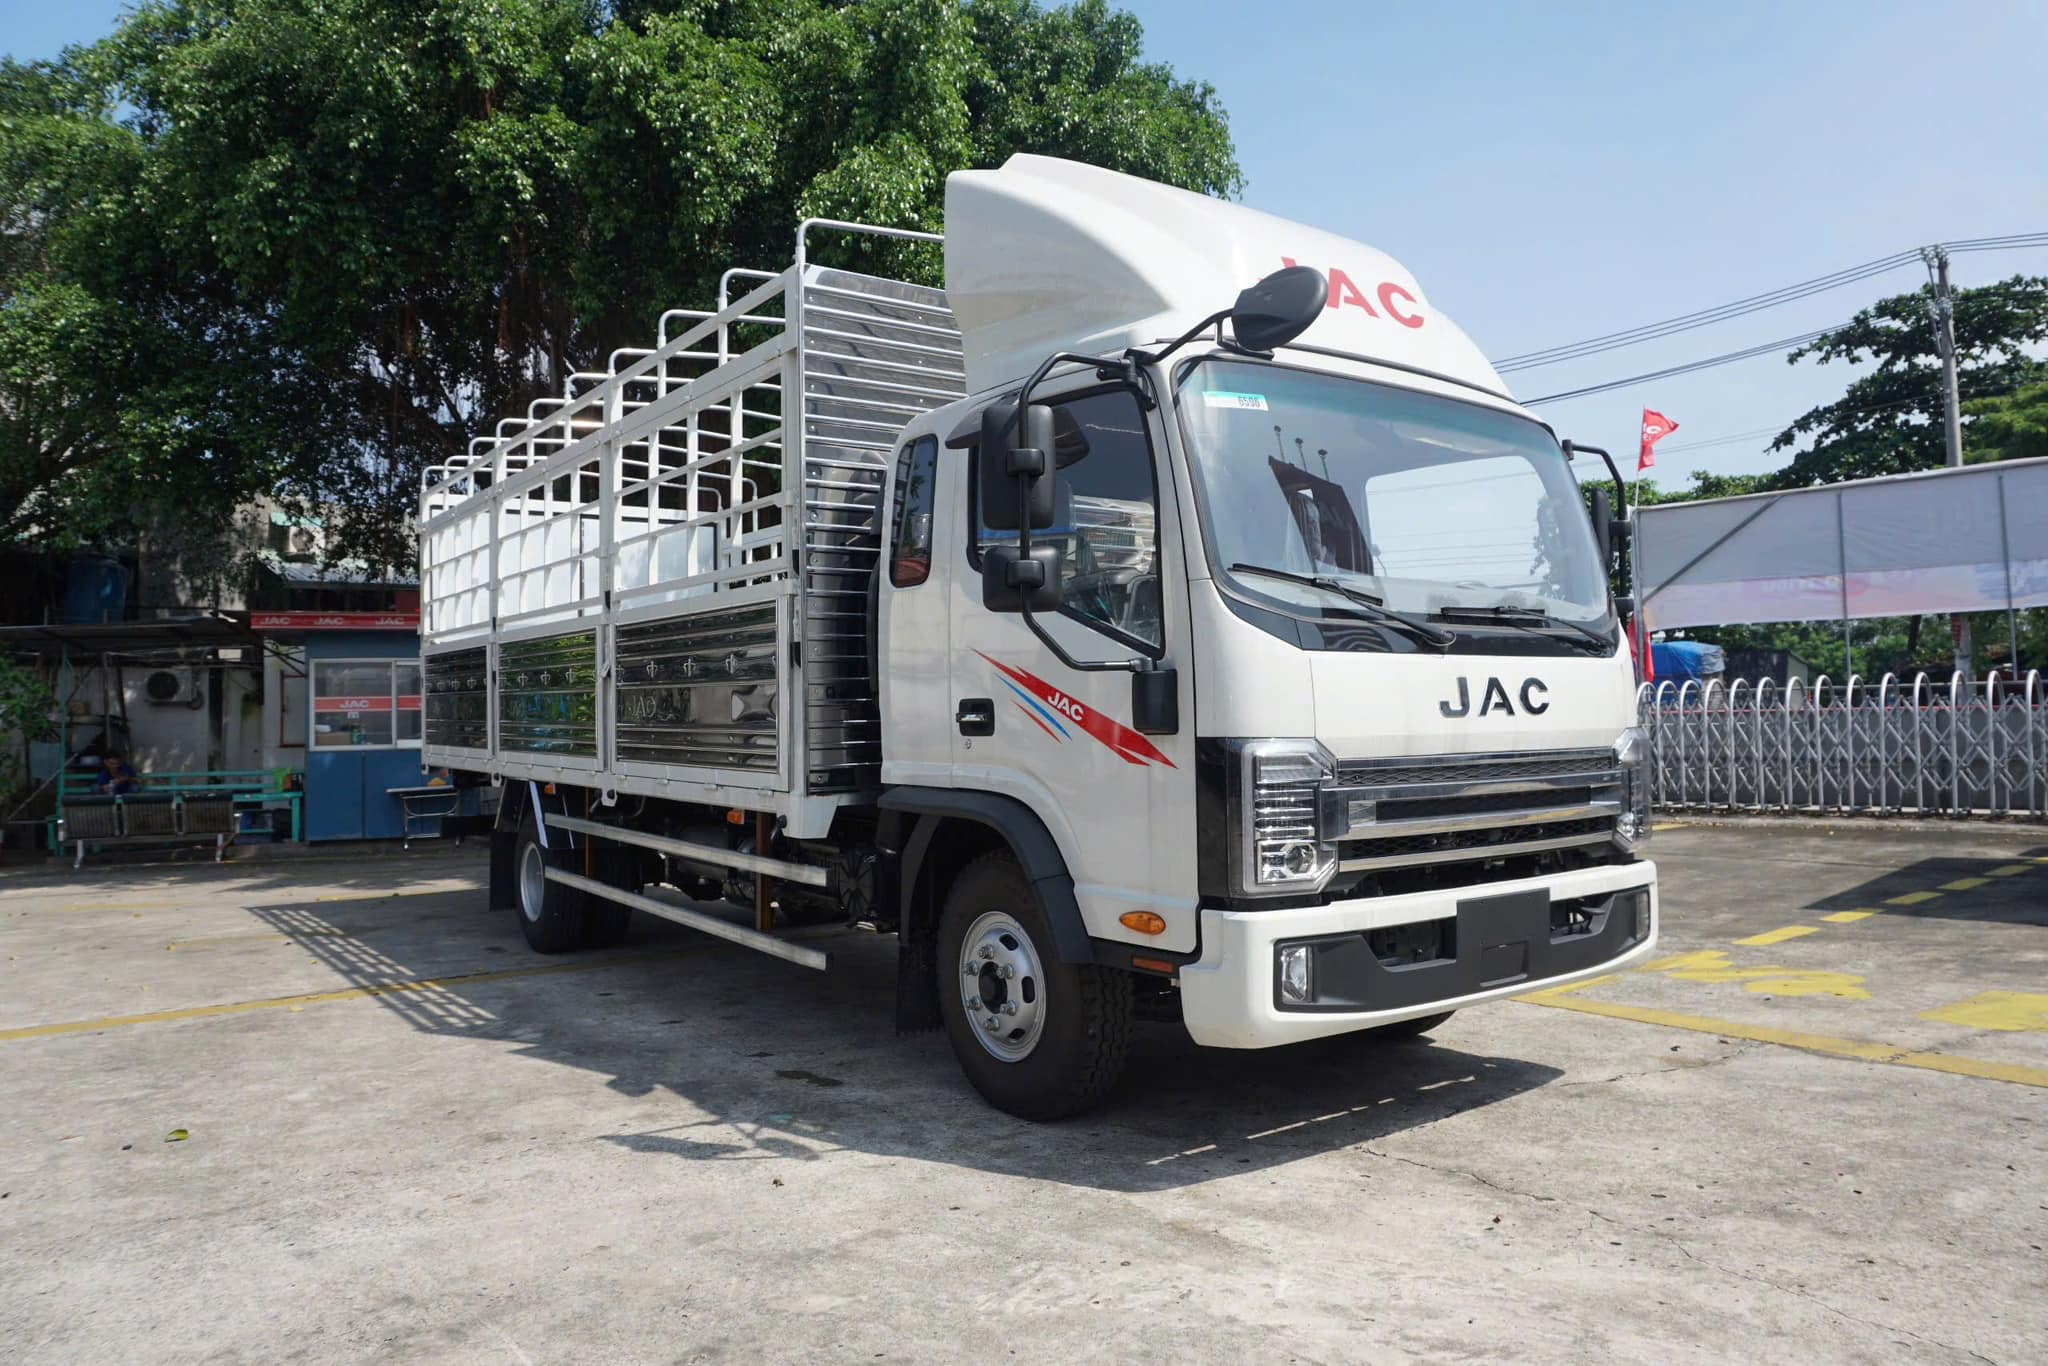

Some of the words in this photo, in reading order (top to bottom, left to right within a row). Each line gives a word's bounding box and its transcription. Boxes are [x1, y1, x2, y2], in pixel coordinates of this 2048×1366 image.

[260, 617, 290, 625] JAC
[314, 617, 344, 625] JAC
[375, 617, 404, 625] JAC
[1439, 677, 1550, 718] JAC
[340, 700, 369, 709] JAC
[1048, 692, 1084, 720] JAC
